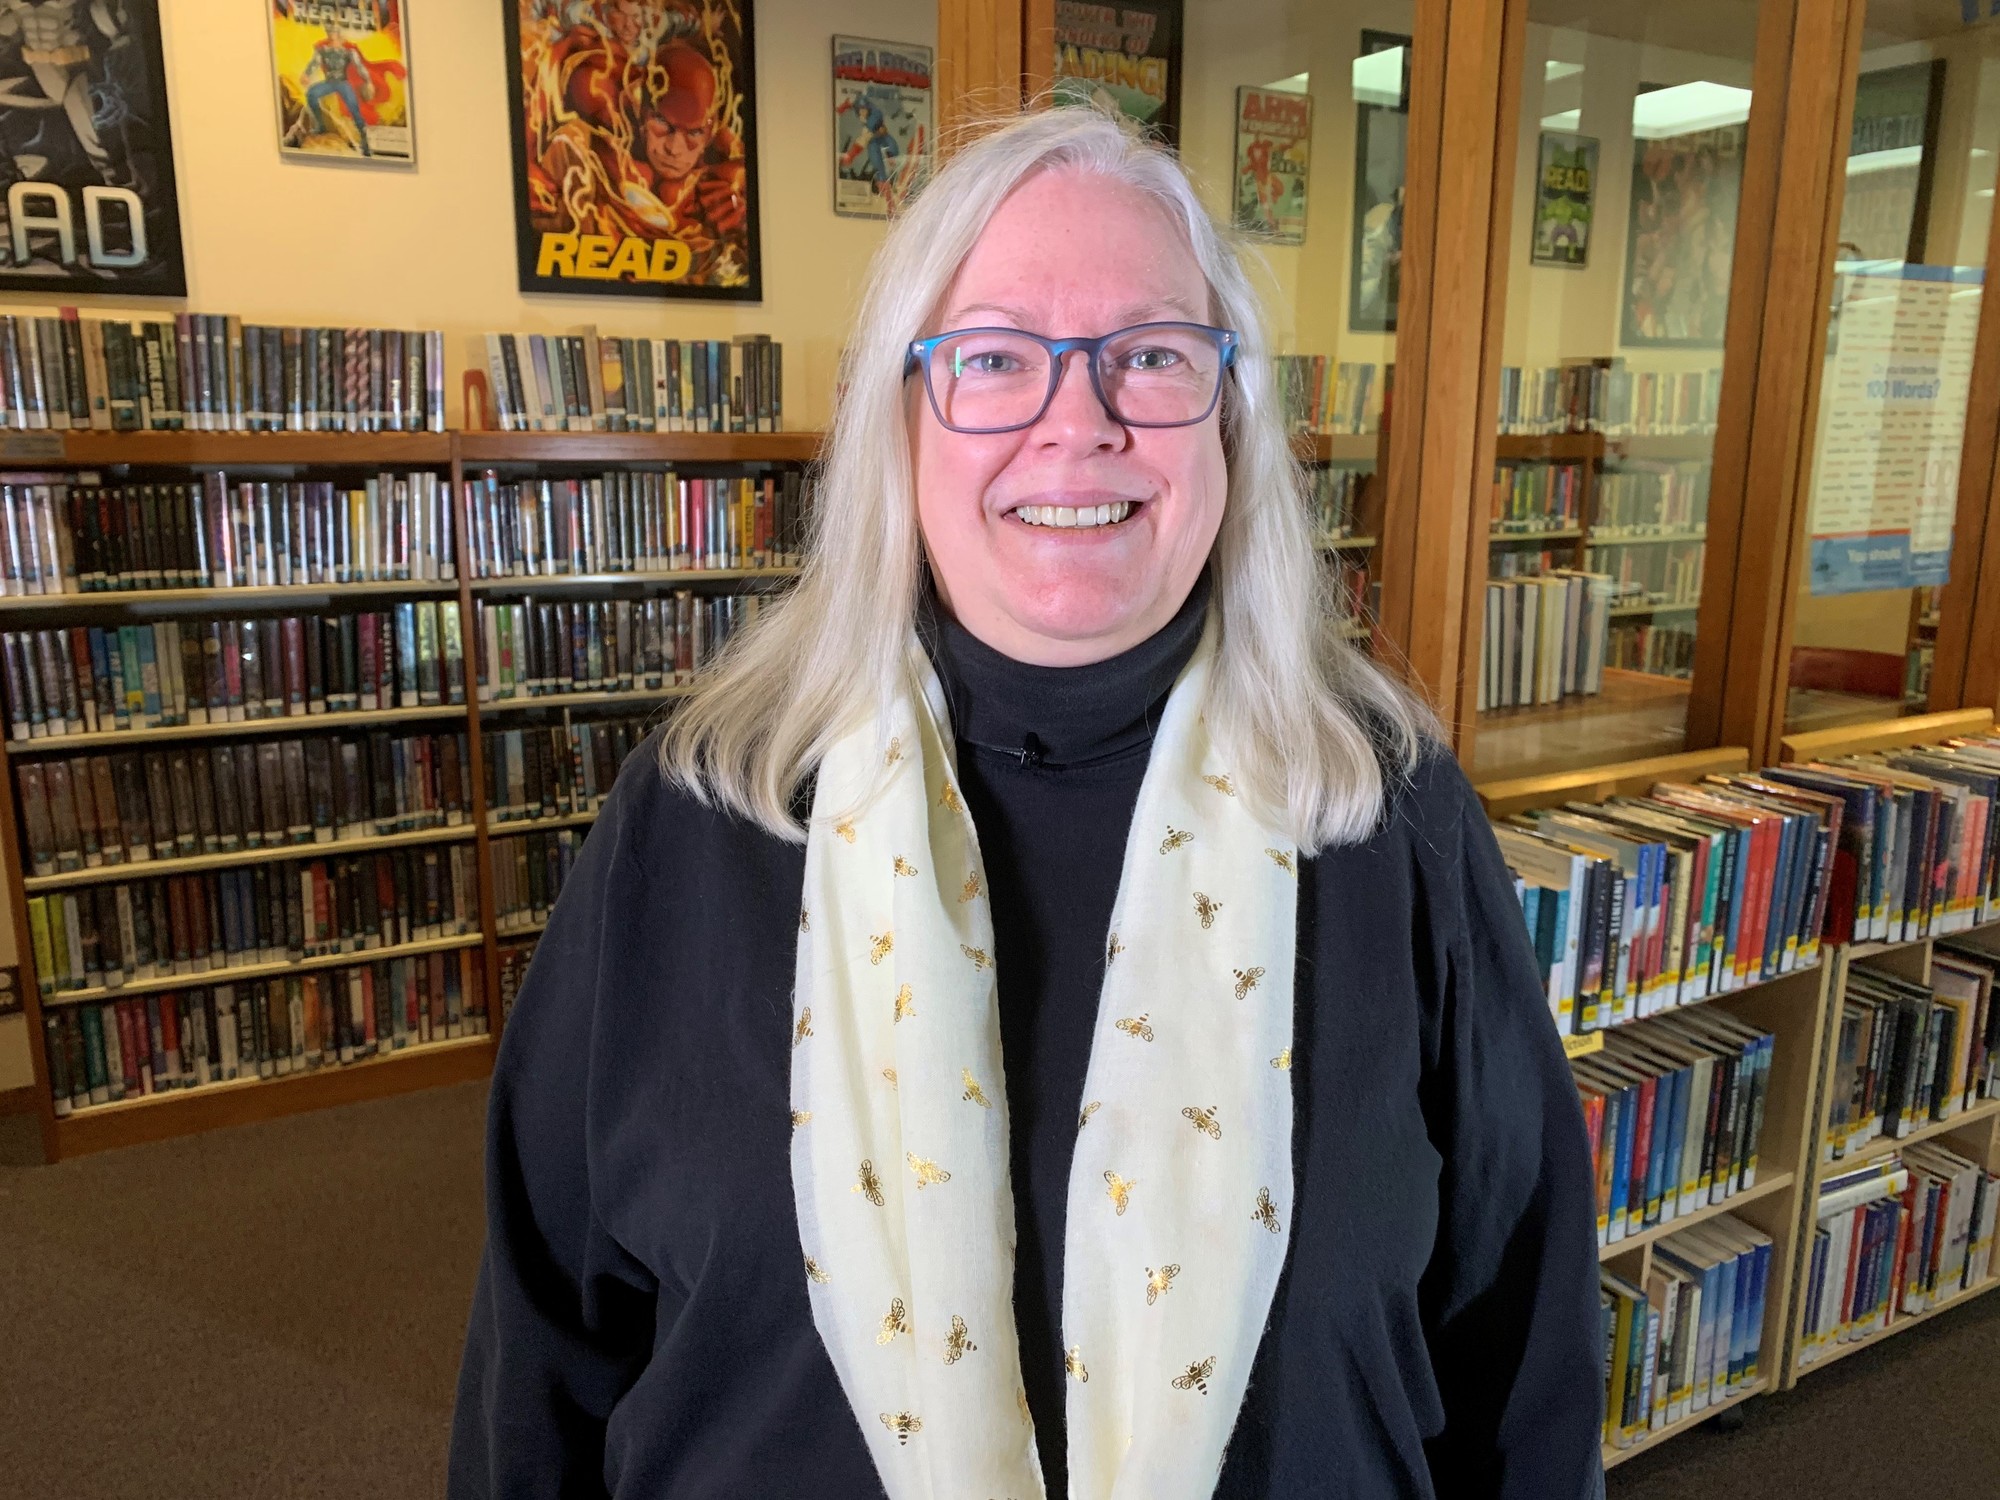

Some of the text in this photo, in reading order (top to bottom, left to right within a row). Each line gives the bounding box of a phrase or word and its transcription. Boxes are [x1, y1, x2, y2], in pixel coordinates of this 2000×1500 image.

[1056, 45, 1167, 101] ADING!
[0, 181, 148, 268] AD
[536, 232, 692, 282] READ
[1609, 880, 1625, 937] INFINITE
